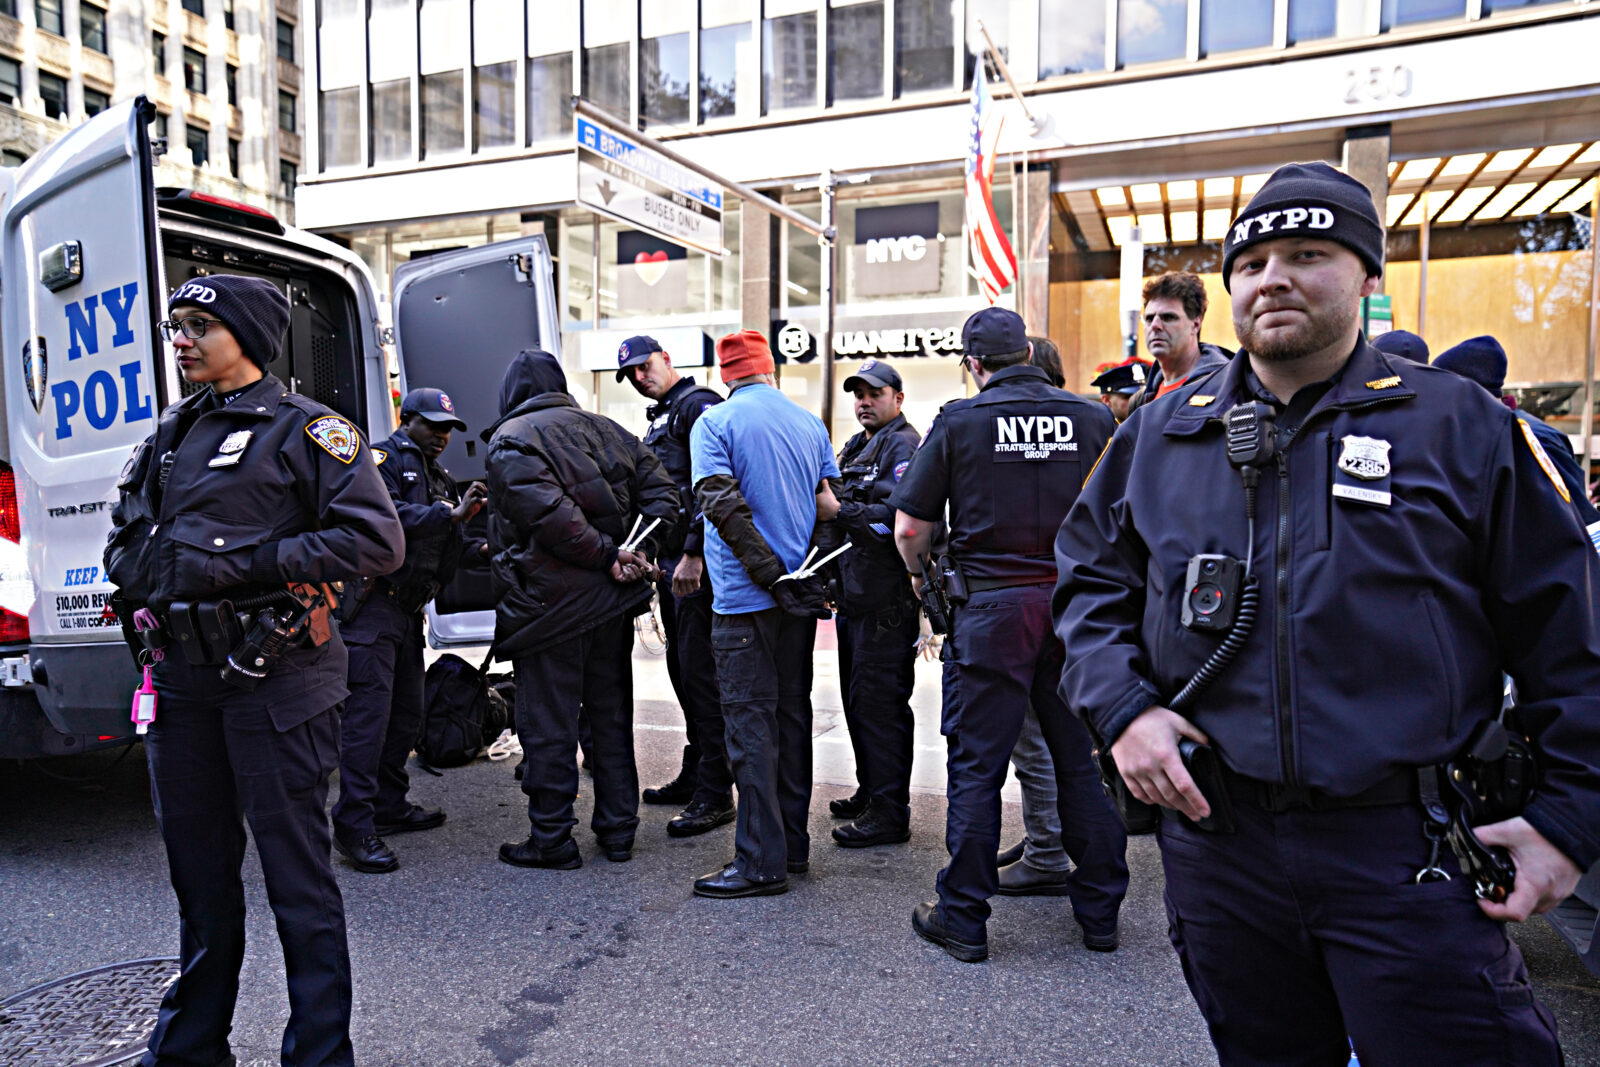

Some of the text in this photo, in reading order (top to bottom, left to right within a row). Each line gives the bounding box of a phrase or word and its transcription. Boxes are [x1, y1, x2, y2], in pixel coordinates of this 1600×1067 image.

[1343, 64, 1413, 104] 250
[600, 134, 659, 177] BROADWAY
[644, 196, 675, 222] BUSES
[678, 211, 701, 232] ONLY
[1233, 207, 1335, 245] NYPD
[866, 235, 927, 263] NYC
[171, 284, 217, 303] YPD
[64, 281, 138, 361] NY
[51, 360, 152, 440] POL
[996, 416, 1074, 443] NYPD
[995, 443, 1077, 452] STRATEGIC RESPONSE
[1024, 451, 1050, 459] GROUP
[1347, 457, 1384, 474] 2386
[47, 501, 107, 517] TRANSIT
[64, 566, 98, 586] KEEP
[56, 592, 113, 611] $10,000 REW
[60, 618, 72, 629] CALL
[72, 617, 87, 628] 1-800
